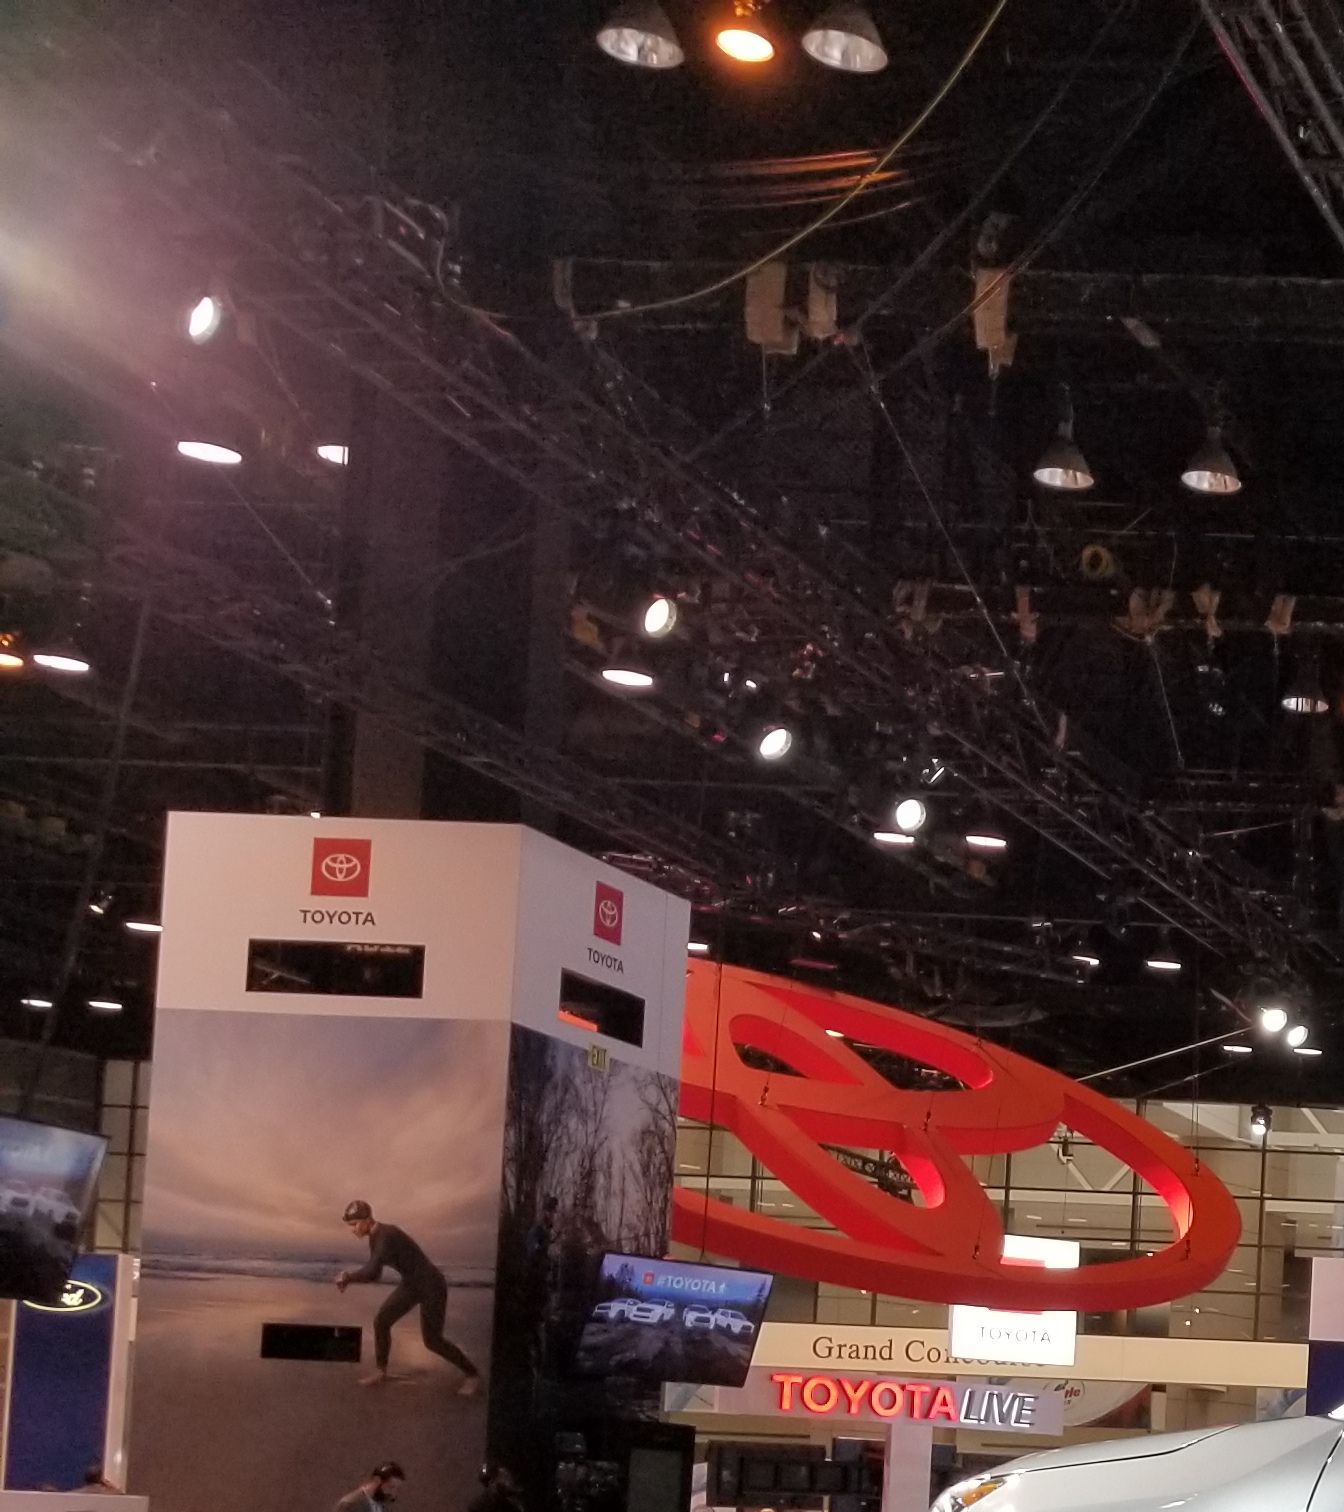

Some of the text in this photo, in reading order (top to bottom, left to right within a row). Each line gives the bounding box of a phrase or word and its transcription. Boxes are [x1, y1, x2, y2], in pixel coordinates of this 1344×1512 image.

[299, 909, 376, 926] TOYOTA
[587, 947, 624, 974] TOYOTA
[979, 1326, 1052, 1343] TOYOTA
[812, 1336, 894, 1361] Grand
